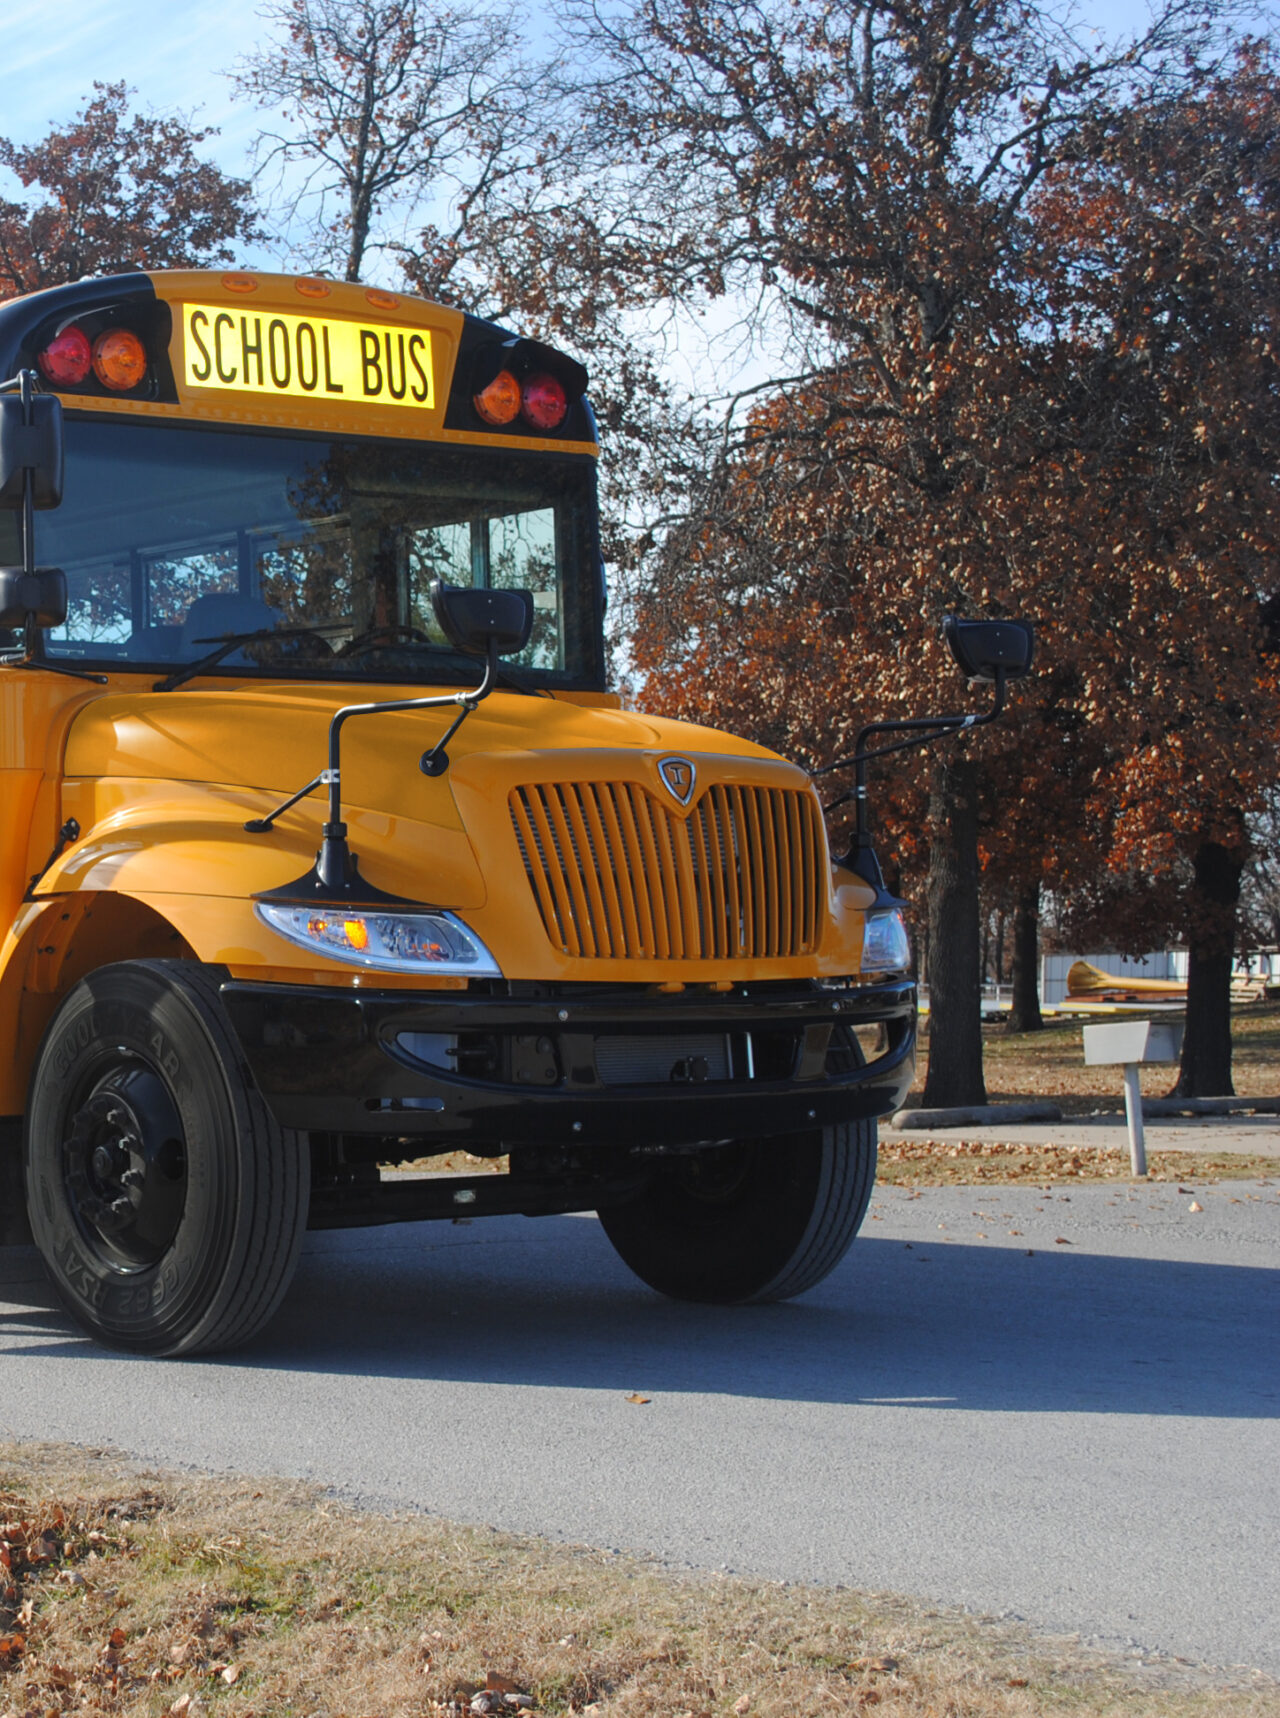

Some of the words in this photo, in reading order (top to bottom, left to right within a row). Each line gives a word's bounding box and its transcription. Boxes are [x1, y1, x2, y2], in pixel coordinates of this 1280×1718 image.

[190, 310, 343, 393] SCHOOL
[360, 330, 429, 402] BUS
[53, 1005, 180, 1079] GOODYEAR
